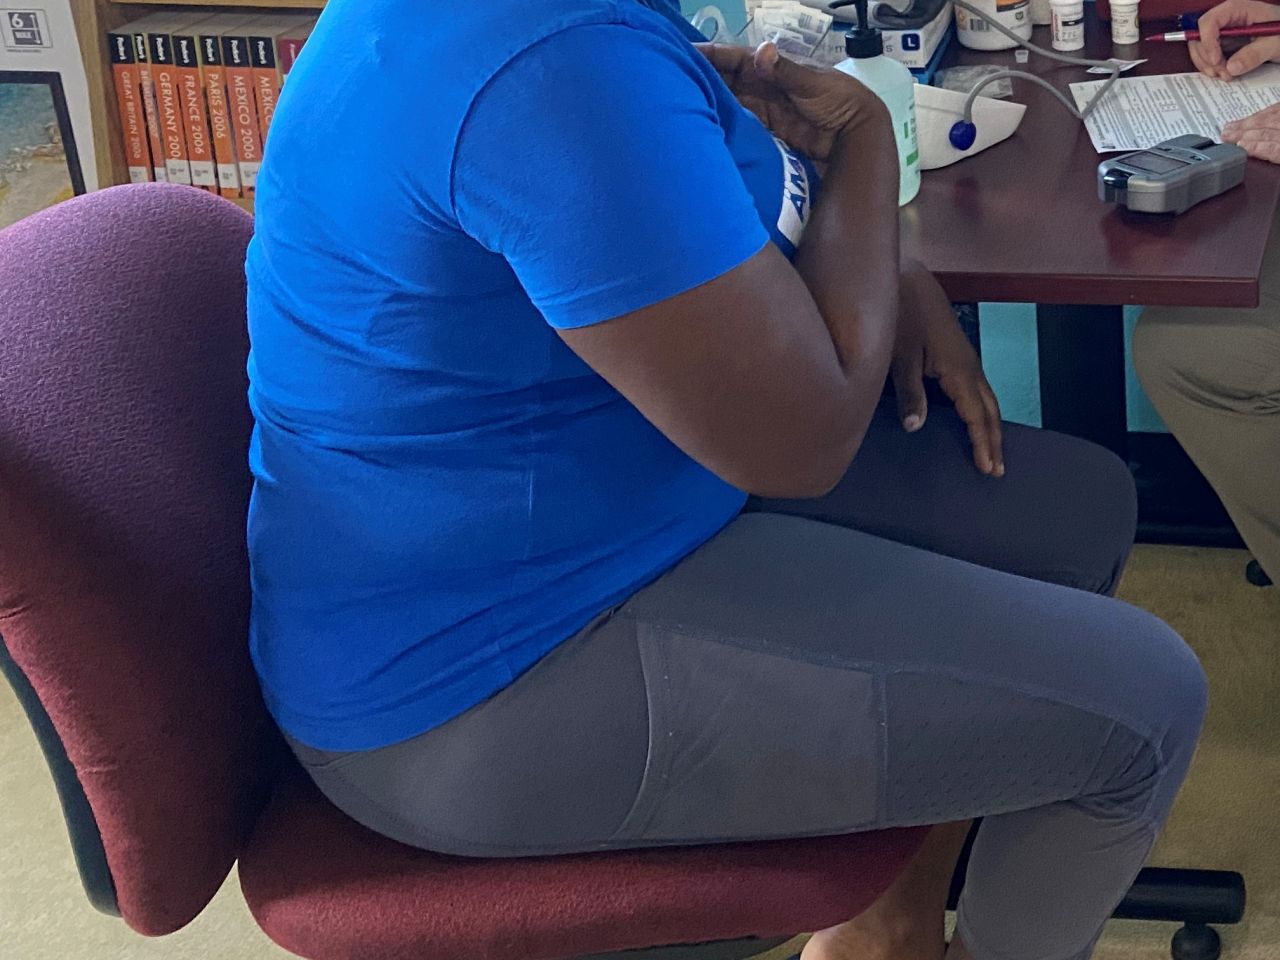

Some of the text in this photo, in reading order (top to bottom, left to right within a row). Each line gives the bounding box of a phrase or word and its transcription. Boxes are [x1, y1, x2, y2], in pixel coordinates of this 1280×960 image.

[907, 38, 916, 48] L
[121, 71, 133, 100] GREAT
[125, 100, 139, 135] BRITAIN
[159, 72, 182, 160] GERMANY 200
[184, 74, 205, 155] FRANCE 2006
[208, 72, 227, 139] PARIS 2006
[233, 75, 256, 160] MEXICO 2006
